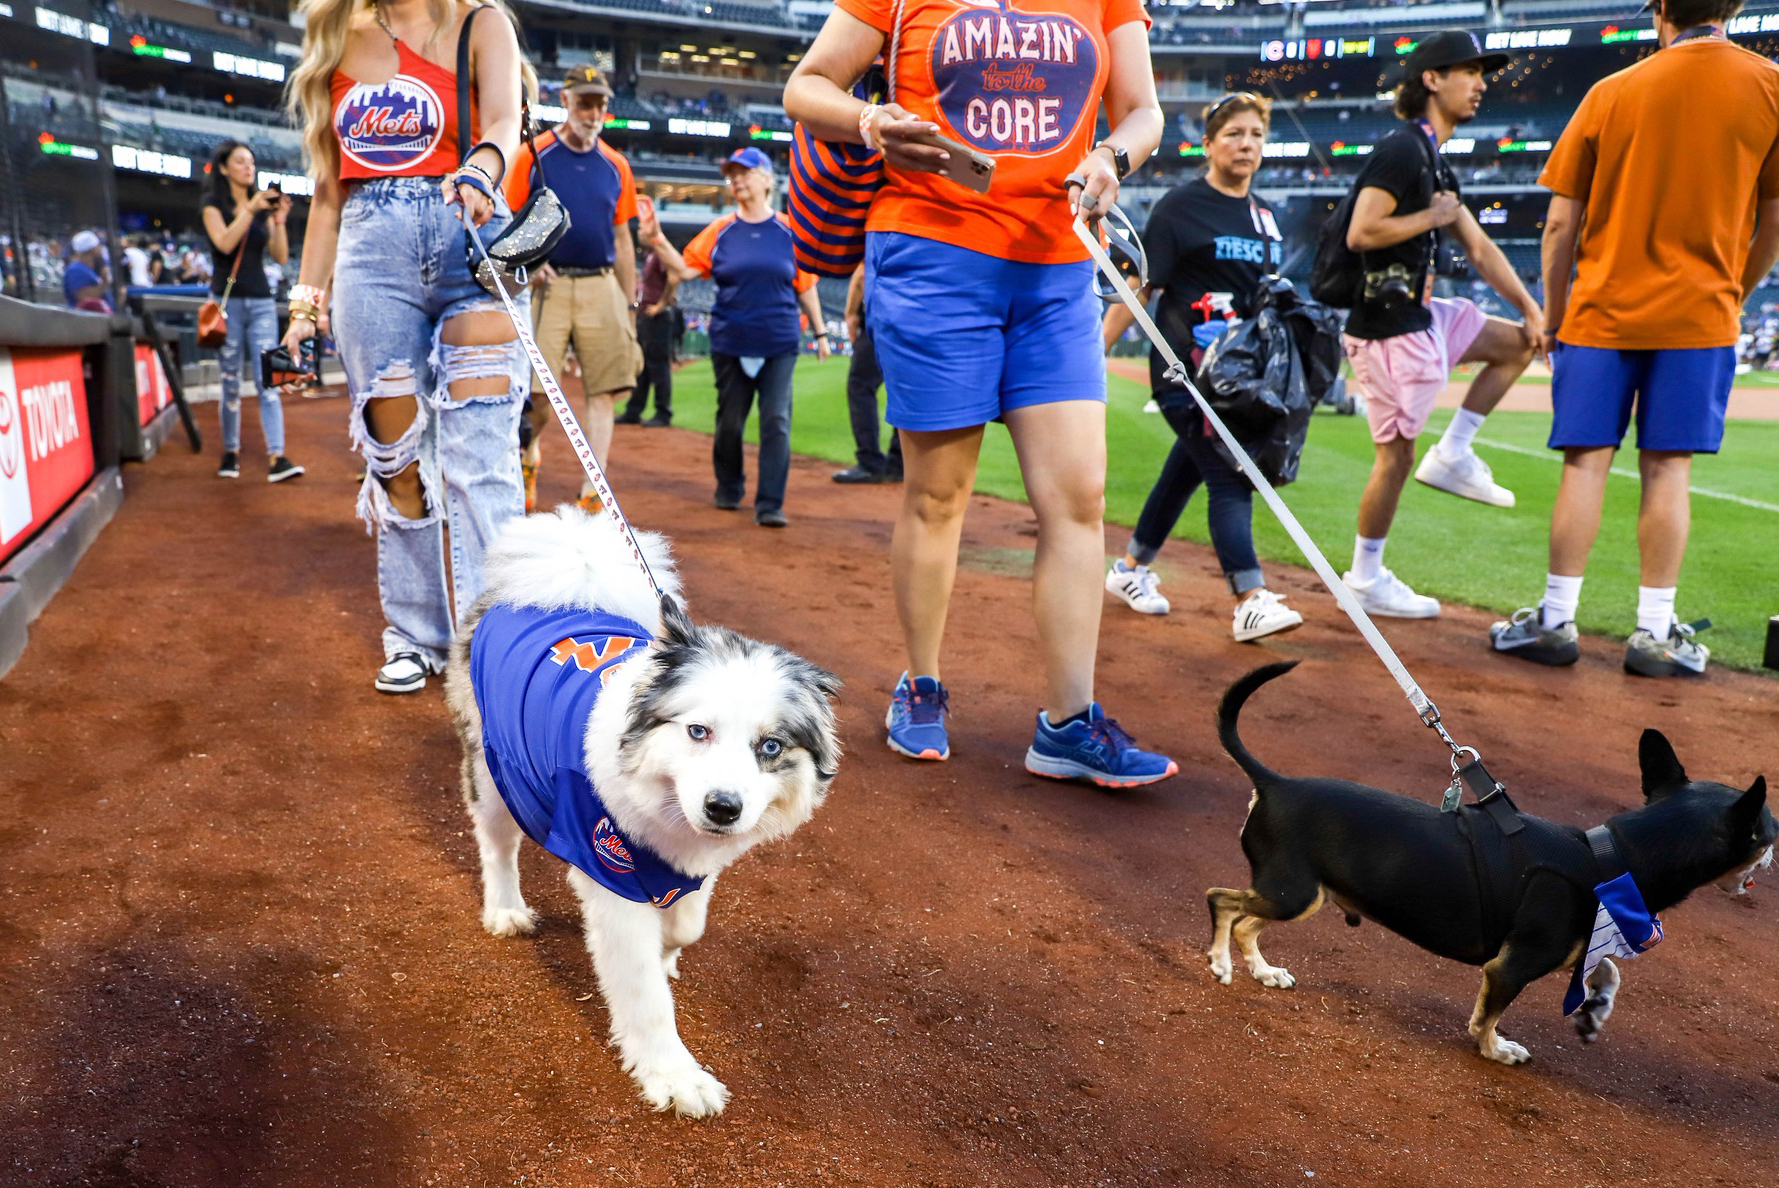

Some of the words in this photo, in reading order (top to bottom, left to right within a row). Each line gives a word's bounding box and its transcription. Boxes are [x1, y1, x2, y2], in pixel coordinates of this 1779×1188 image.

[1761, 13, 1779, 32] NO
[943, 16, 1083, 66] AMAZIN'
[981, 62, 1011, 92] to
[1009, 63, 1047, 92] the
[349, 106, 422, 138] Mets
[966, 97, 1061, 143] CORE
[21, 380, 79, 461] TOYOTA
[600, 834, 634, 863] Me
